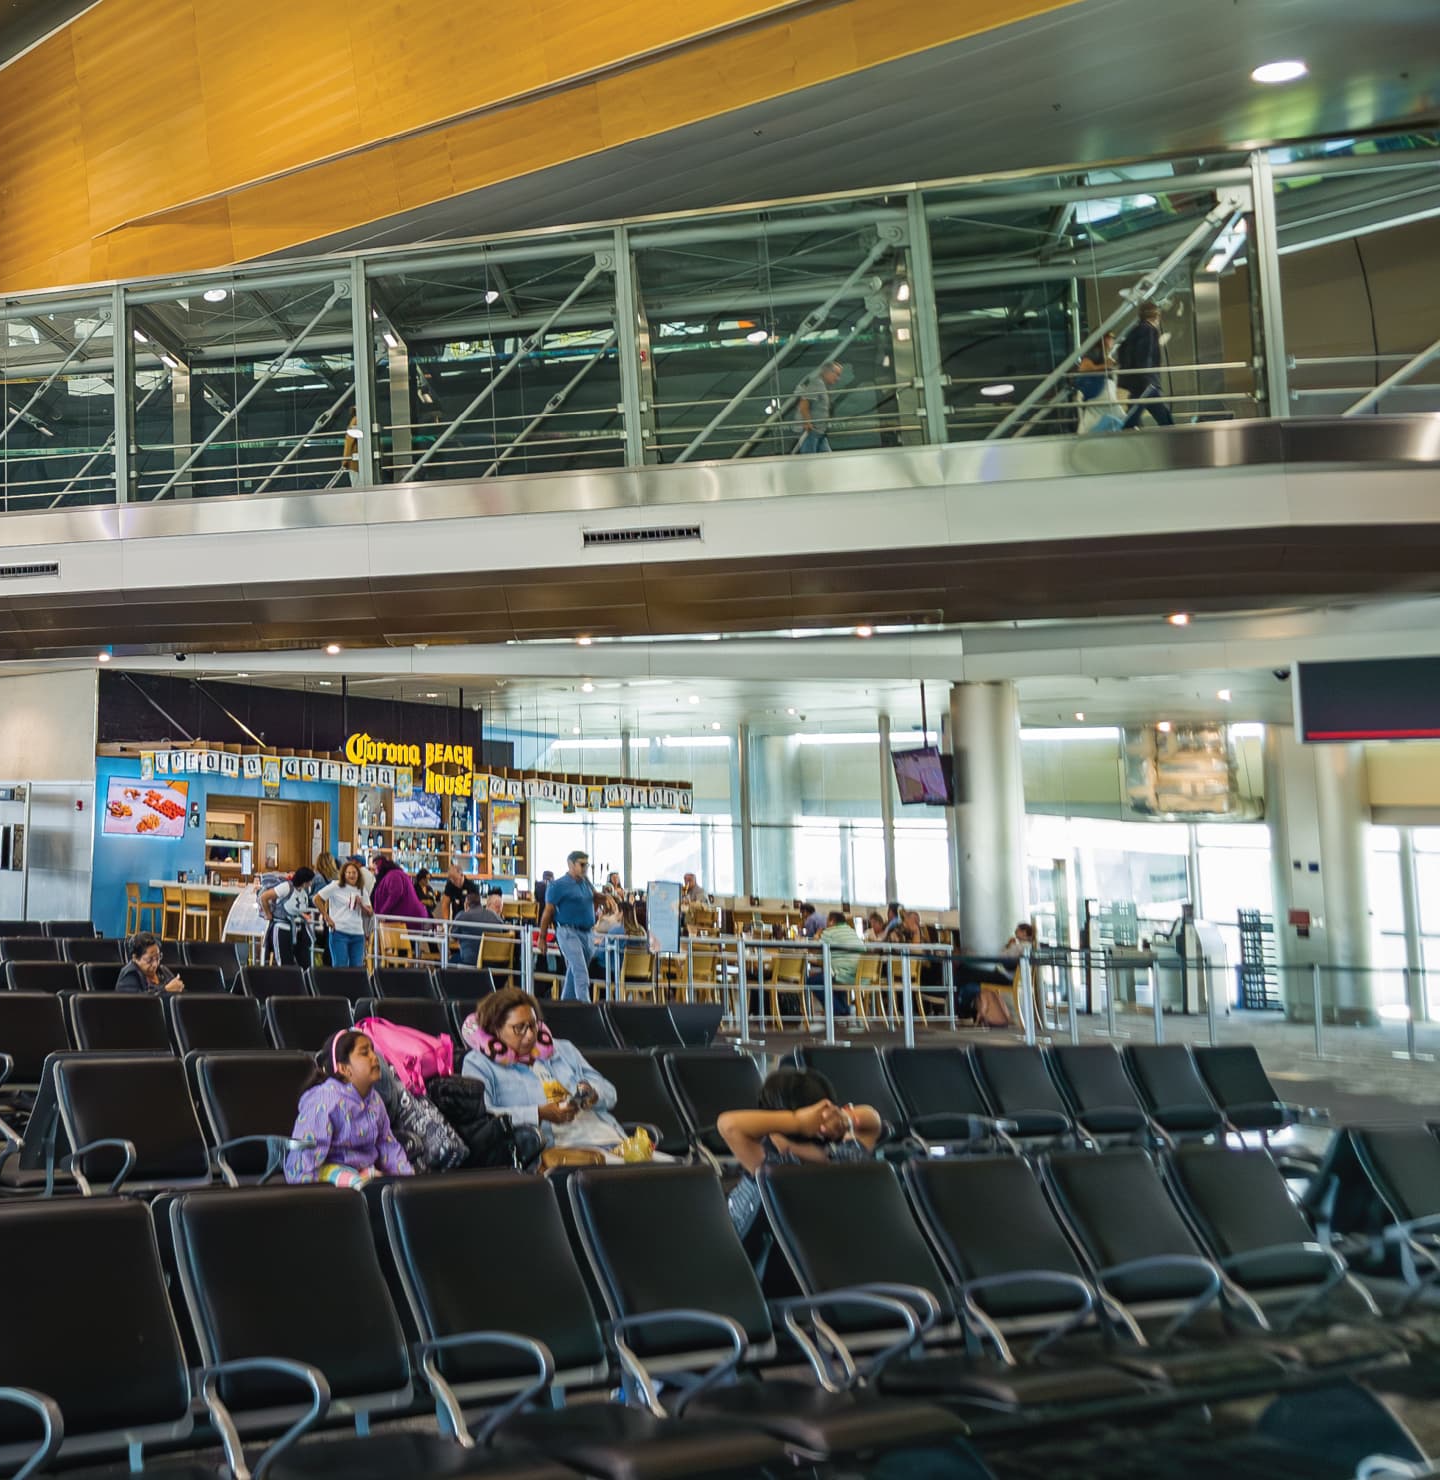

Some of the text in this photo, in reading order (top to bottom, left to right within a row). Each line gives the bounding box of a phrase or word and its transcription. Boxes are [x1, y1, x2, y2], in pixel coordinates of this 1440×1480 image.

[157, 751, 391, 785] Corona Corona
[345, 733, 473, 771] Corona BEACH
[425, 769, 472, 797] HOUSE
